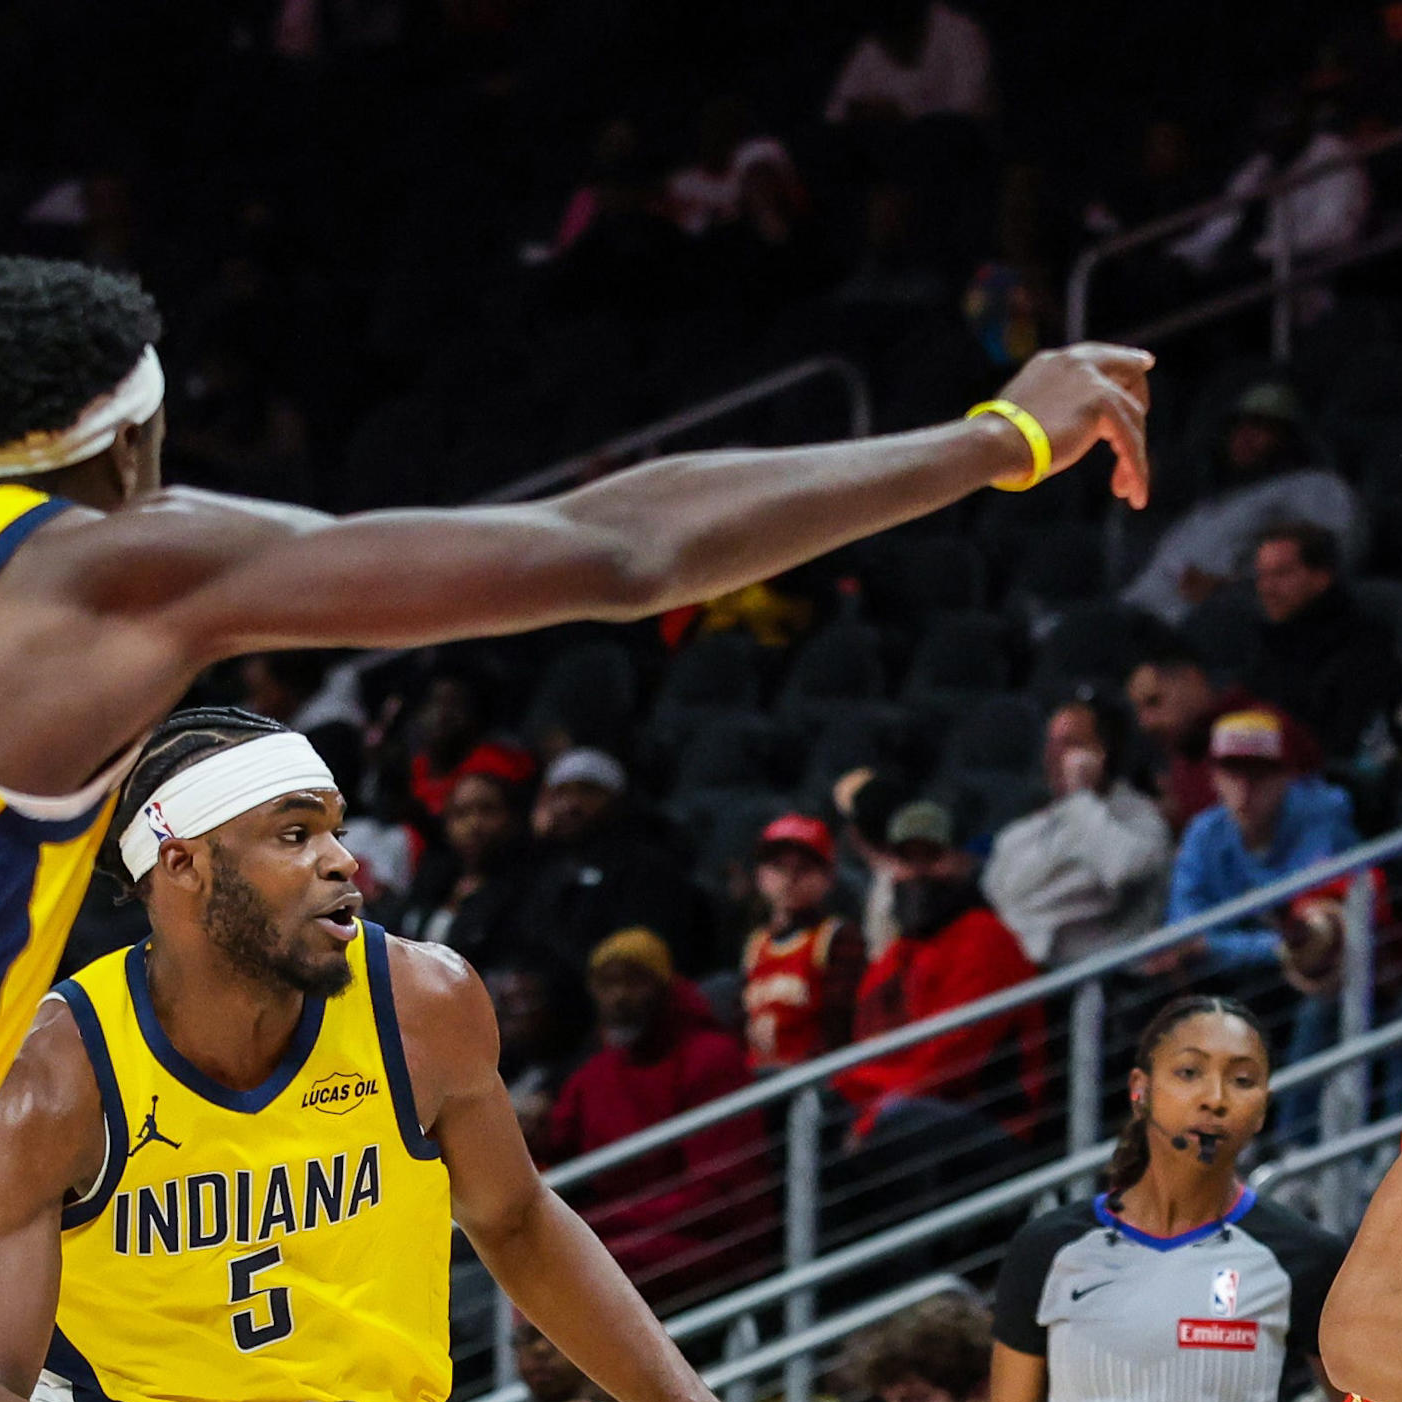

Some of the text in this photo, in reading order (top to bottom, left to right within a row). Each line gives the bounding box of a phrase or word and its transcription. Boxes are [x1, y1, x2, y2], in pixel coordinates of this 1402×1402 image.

[301, 1080, 379, 1108] LUCAS OIL
[113, 1143, 382, 1257] INDIANA
[227, 1243, 295, 1355] 5
[1180, 1323, 1257, 1346] Emirates
